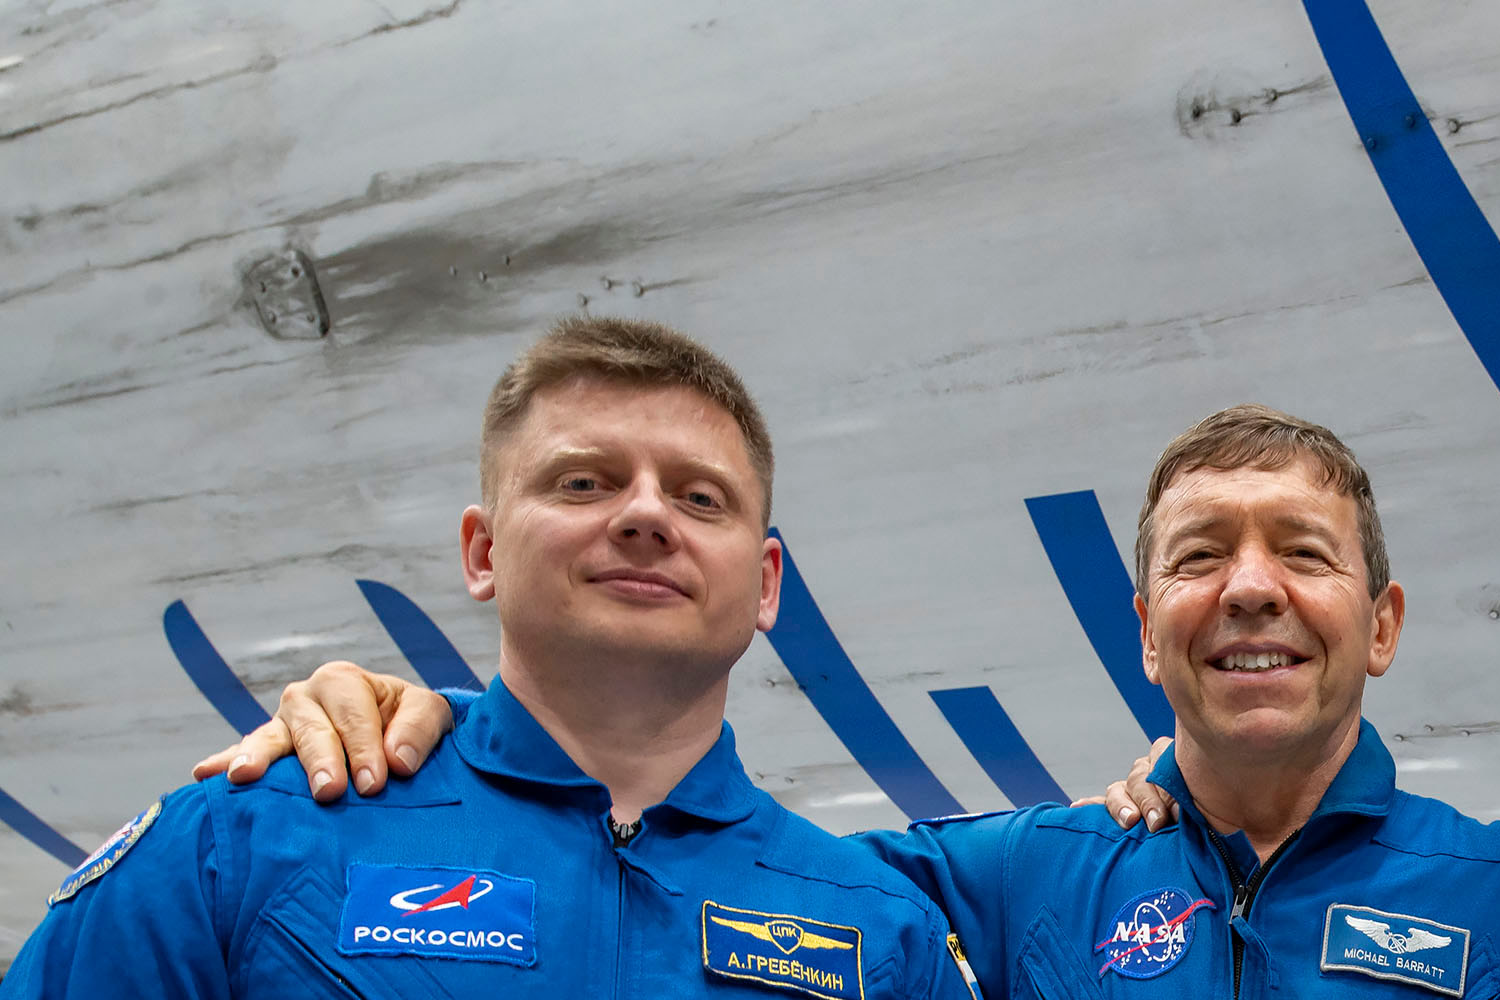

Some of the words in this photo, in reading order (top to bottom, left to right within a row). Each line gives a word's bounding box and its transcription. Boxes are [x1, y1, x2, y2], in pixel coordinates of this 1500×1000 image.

[354, 925, 524, 951] РОСКОСМОС
[772, 925, 797, 938] ЦПК
[1111, 922, 1186, 943] NASA
[1344, 948, 1390, 967] MICHAEL
[1396, 957, 1445, 979] BARRATT
